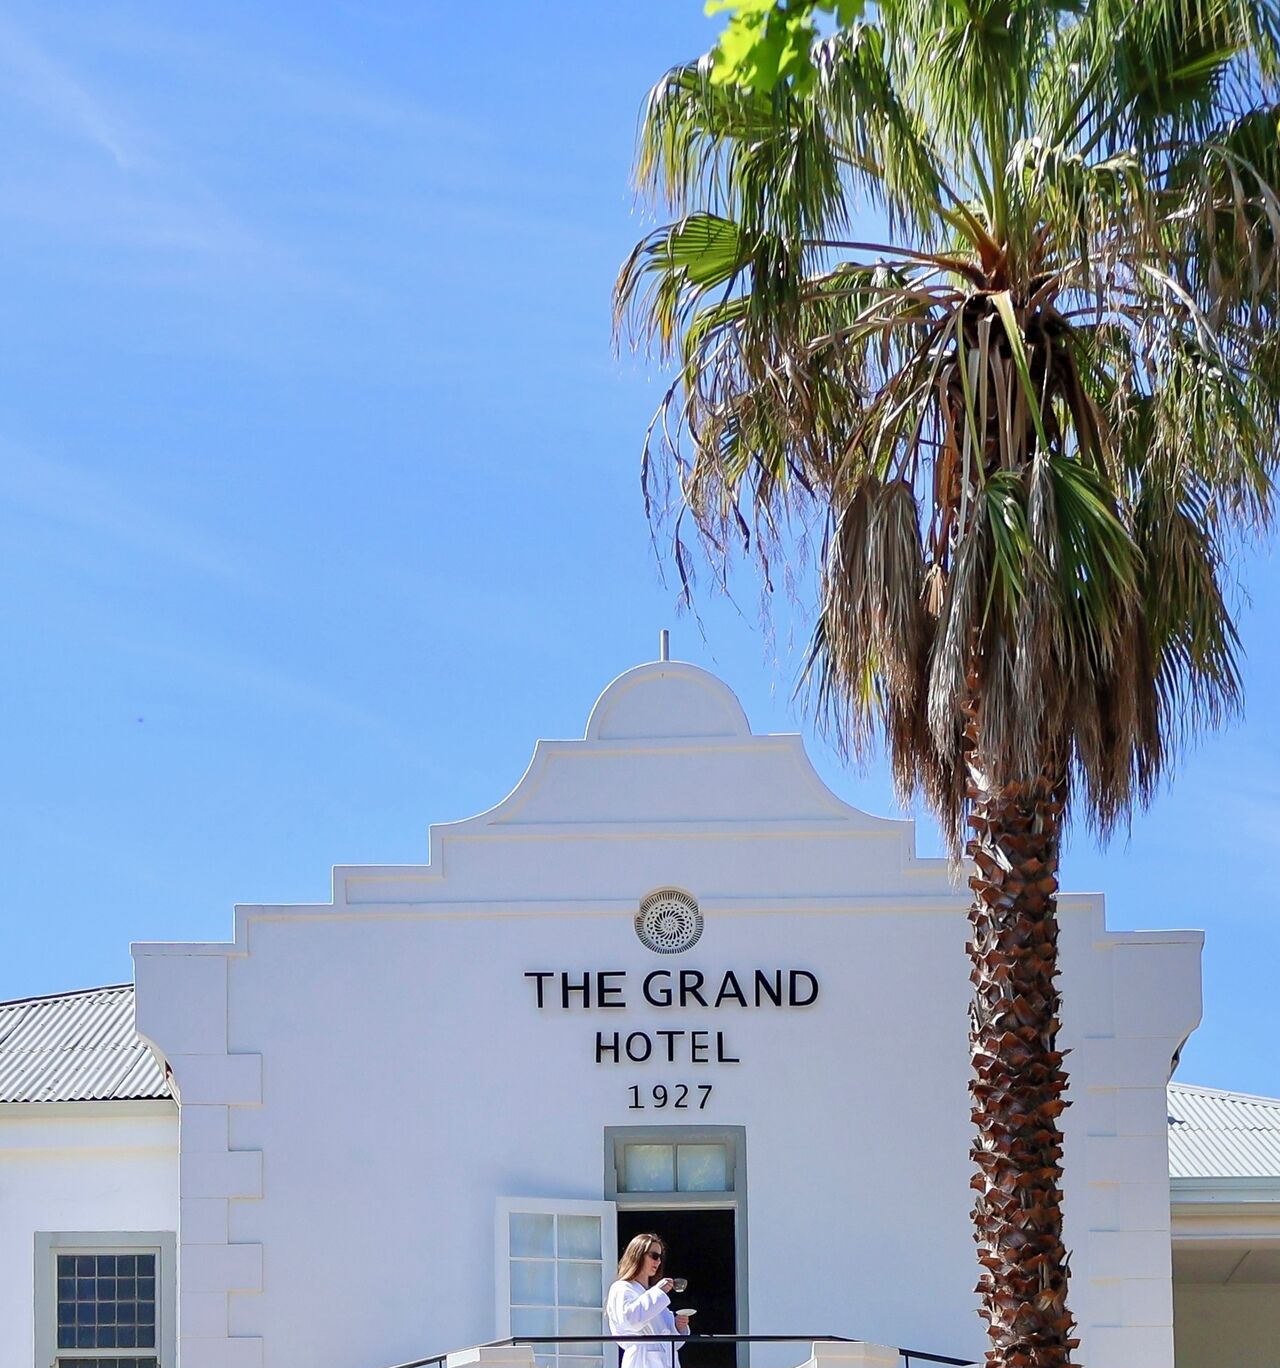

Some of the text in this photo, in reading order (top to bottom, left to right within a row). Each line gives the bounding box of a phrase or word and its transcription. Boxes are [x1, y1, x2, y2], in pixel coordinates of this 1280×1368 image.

[524, 969, 819, 1009] THE GRAND
[595, 1031, 740, 1063] HOTEL
[628, 1084, 713, 1109] 1927
